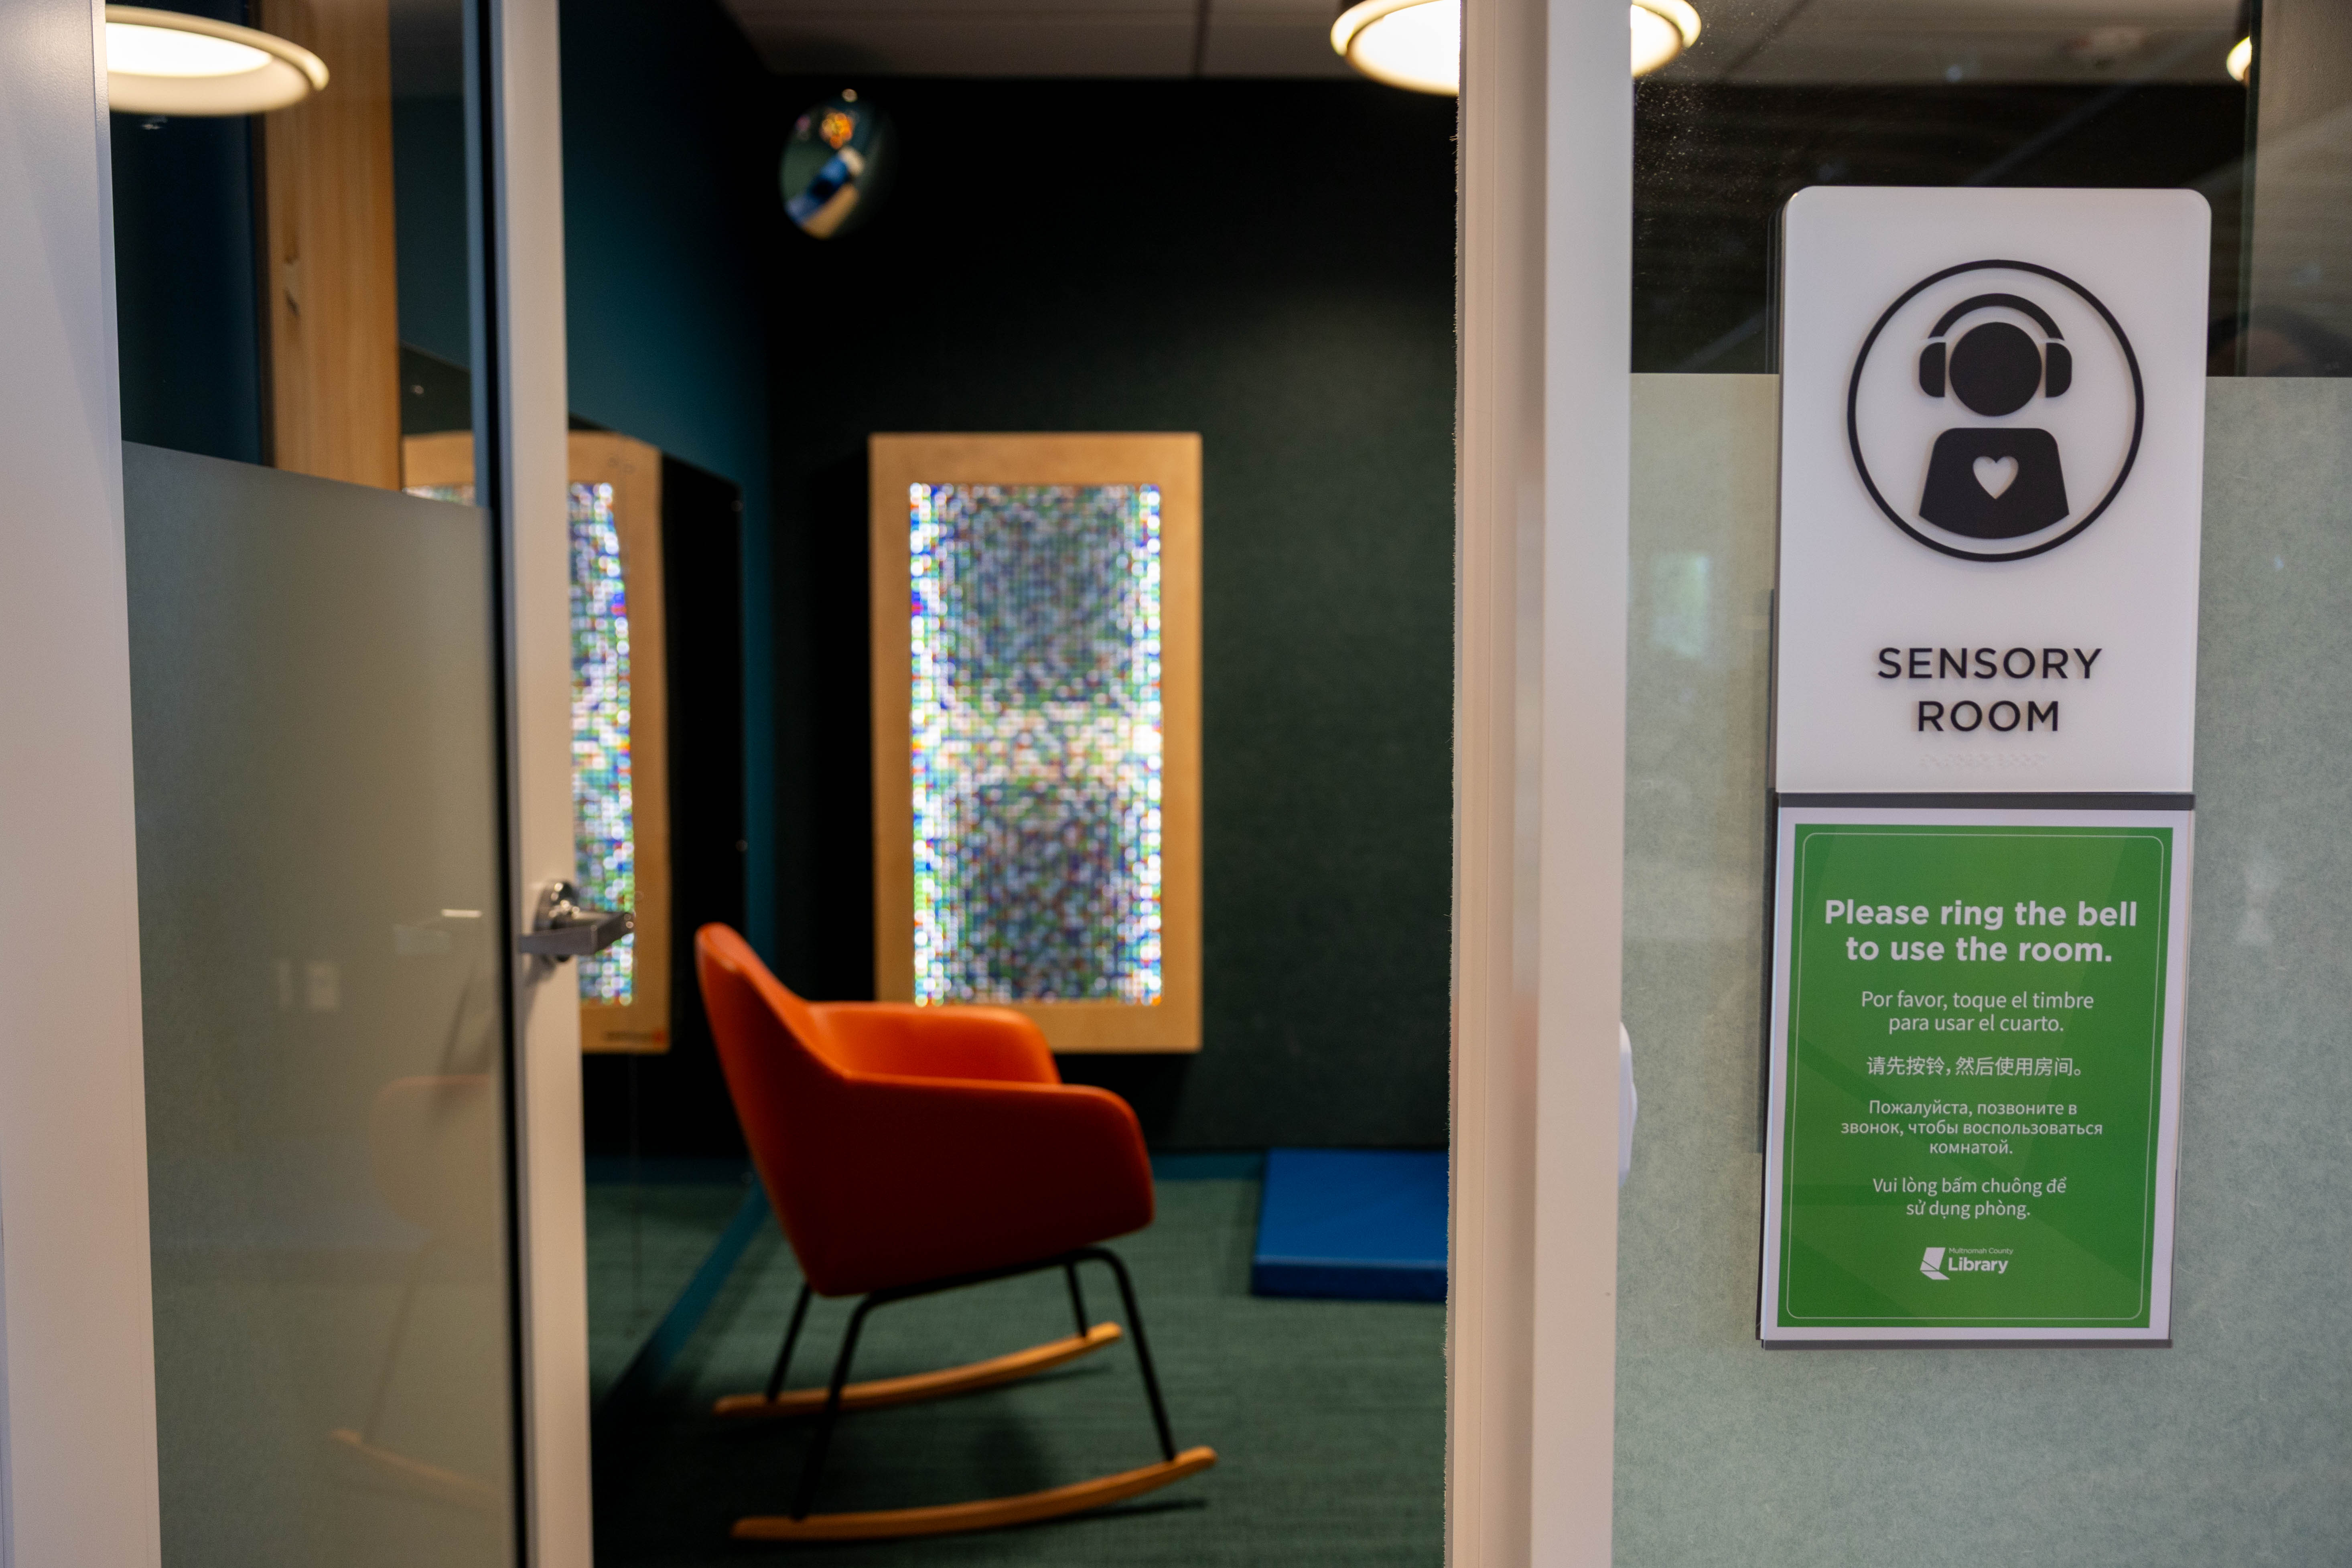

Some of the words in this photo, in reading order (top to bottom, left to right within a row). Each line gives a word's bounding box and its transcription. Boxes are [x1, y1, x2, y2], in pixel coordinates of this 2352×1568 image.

[1879, 648, 2102, 679] SENSORY
[1919, 701, 2058, 732] ROOM
[1826, 899, 1929, 925] Please
[1941, 900, 2003, 930] ring
[2015, 901, 2066, 926] the
[2078, 901, 2136, 926] bell
[1846, 937, 1879, 960] to
[1891, 942, 1944, 961] use
[1956, 936, 2007, 961] the
[2019, 943, 2111, 961] room.
[1862, 991, 1893, 1007] Por
[1897, 990, 1947, 1010] favor,
[1953, 993, 2006, 1012] toque
[2012, 991, 2027, 1008] el
[2033, 992, 2094, 1008] timbre
[1889, 1018, 1928, 1034] para
[1935, 1018, 1974, 1030] usar
[1979, 1014, 1994, 1031] el
[2000, 1016, 2063, 1031] cuarto.
[1870, 1100, 1972, 1118] Пожалуйста,
[1978, 1104, 2064, 1114] позвоните
[2069, 1105, 2077, 1115] в
[1842, 1123, 1904, 1136] звонок,
[1909, 1120, 1958, 1134] чтобы
[1963, 1124, 2102, 1134] воспользоваться
[1930, 1140, 2012, 1154] комнатой.
[1873, 1178, 1897, 1192] Vui
[1903, 1177, 1937, 1196] lòng
[1942, 1177, 1977, 1193] bấm
[1982, 1177, 2042, 1197] chuông
[2046, 1177, 2066, 1193] để
[1907, 1200, 1926, 1215] sử
[1929, 1201, 1970, 1219] dụng
[1975, 1199, 2030, 1219] phòng.
[1948, 1257, 2008, 1274] Library
